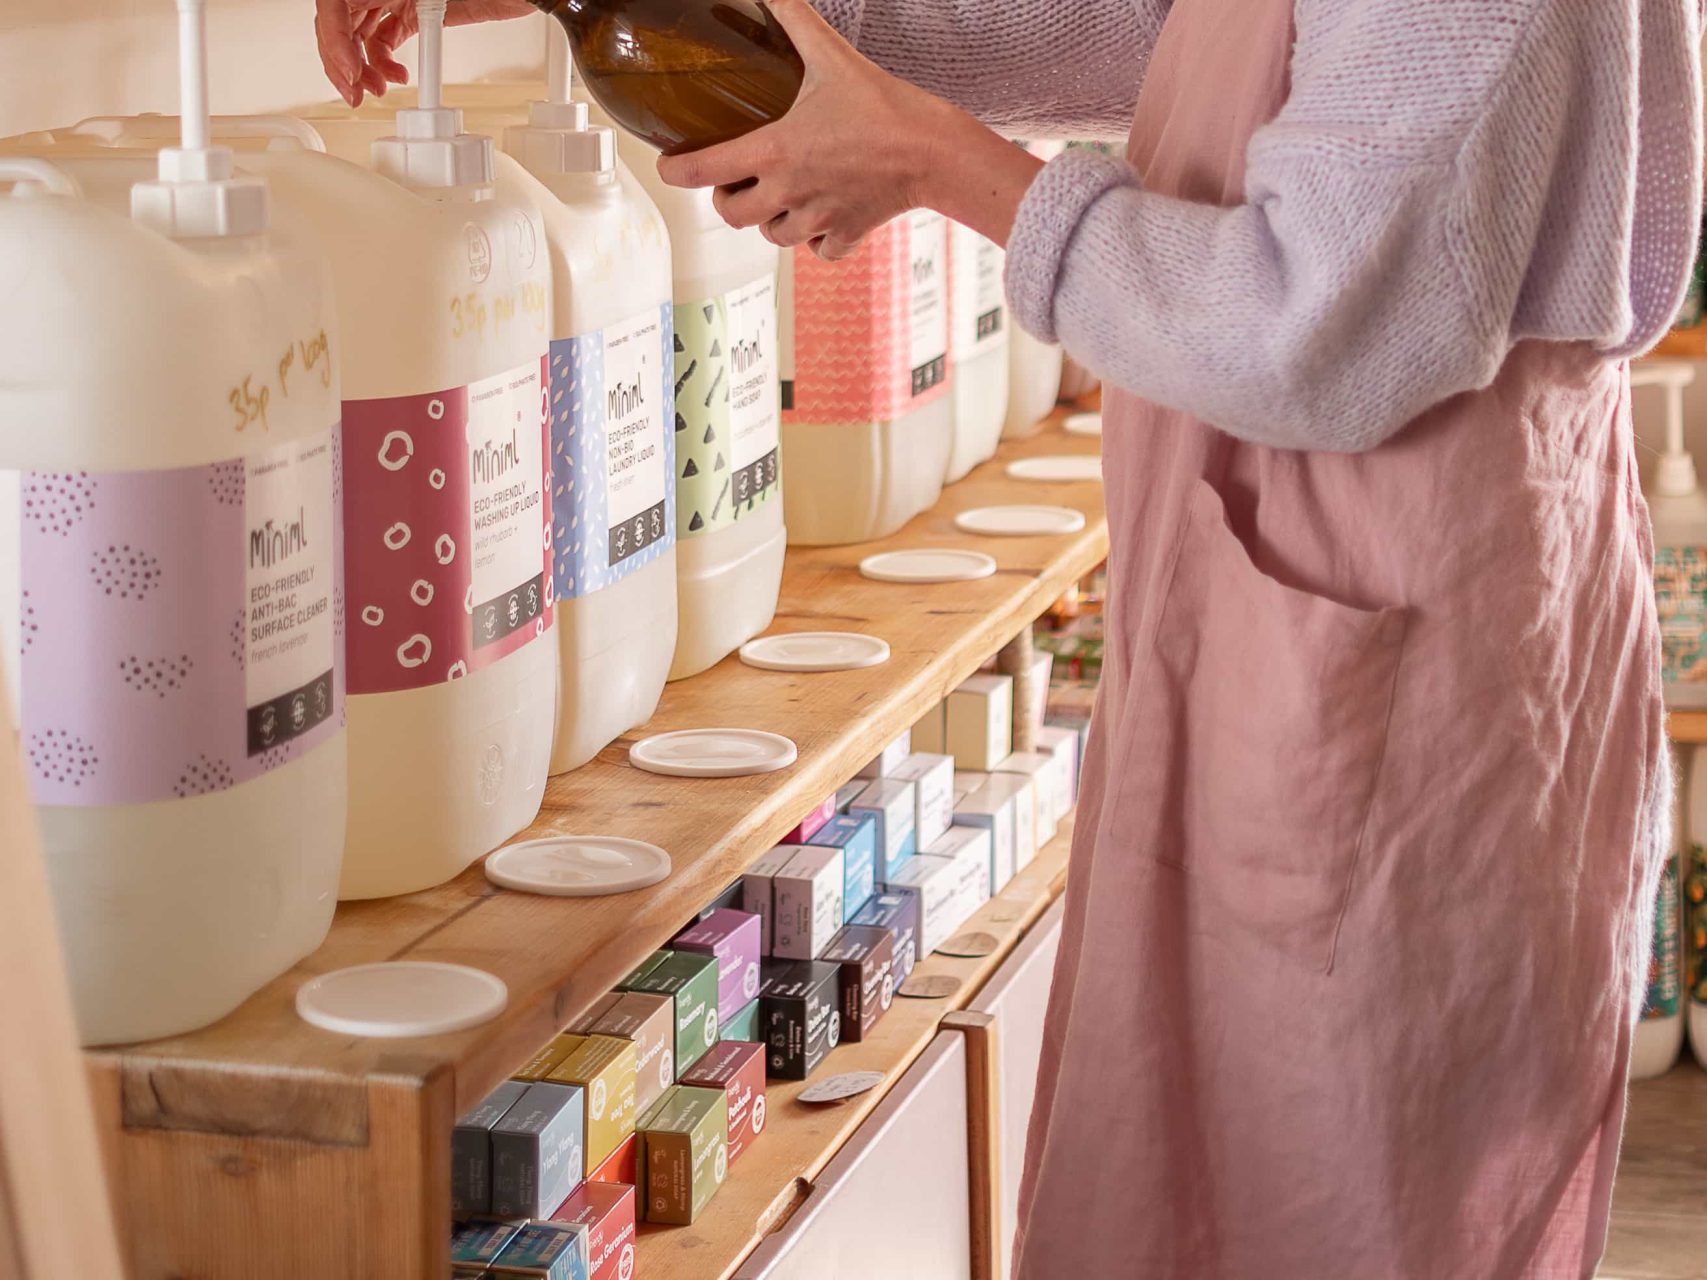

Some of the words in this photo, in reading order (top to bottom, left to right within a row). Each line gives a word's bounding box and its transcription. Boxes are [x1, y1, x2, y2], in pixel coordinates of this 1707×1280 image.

[608, 415, 650, 445] ECO-FRIENDLY
[608, 439, 635, 460] NON-BIO
[608, 453, 637, 476] LAUNDRY
[638, 444, 656, 463] LIQUID
[474, 480, 527, 514] ECO-FRIENDLY
[474, 503, 510, 532] WASHING
[511, 500, 520, 517] UP
[520, 490, 540, 513] LIQUID
[250, 565, 315, 604] ECO-FRIENDLY
[250, 593, 297, 624] ANTI-BAC
[251, 612, 295, 643] SURFACE
[297, 596, 328, 626] CLEANER
[680, 1001, 706, 1032] Rosemary
[728, 1086, 752, 1121] Patchouli
[543, 1151, 559, 1175] Ylang
[558, 1132, 575, 1156] Ylang
[693, 1132, 721, 1173] Lemongrass
[590, 1253, 604, 1277] Rose
[603, 1222, 635, 1260] Geranium
